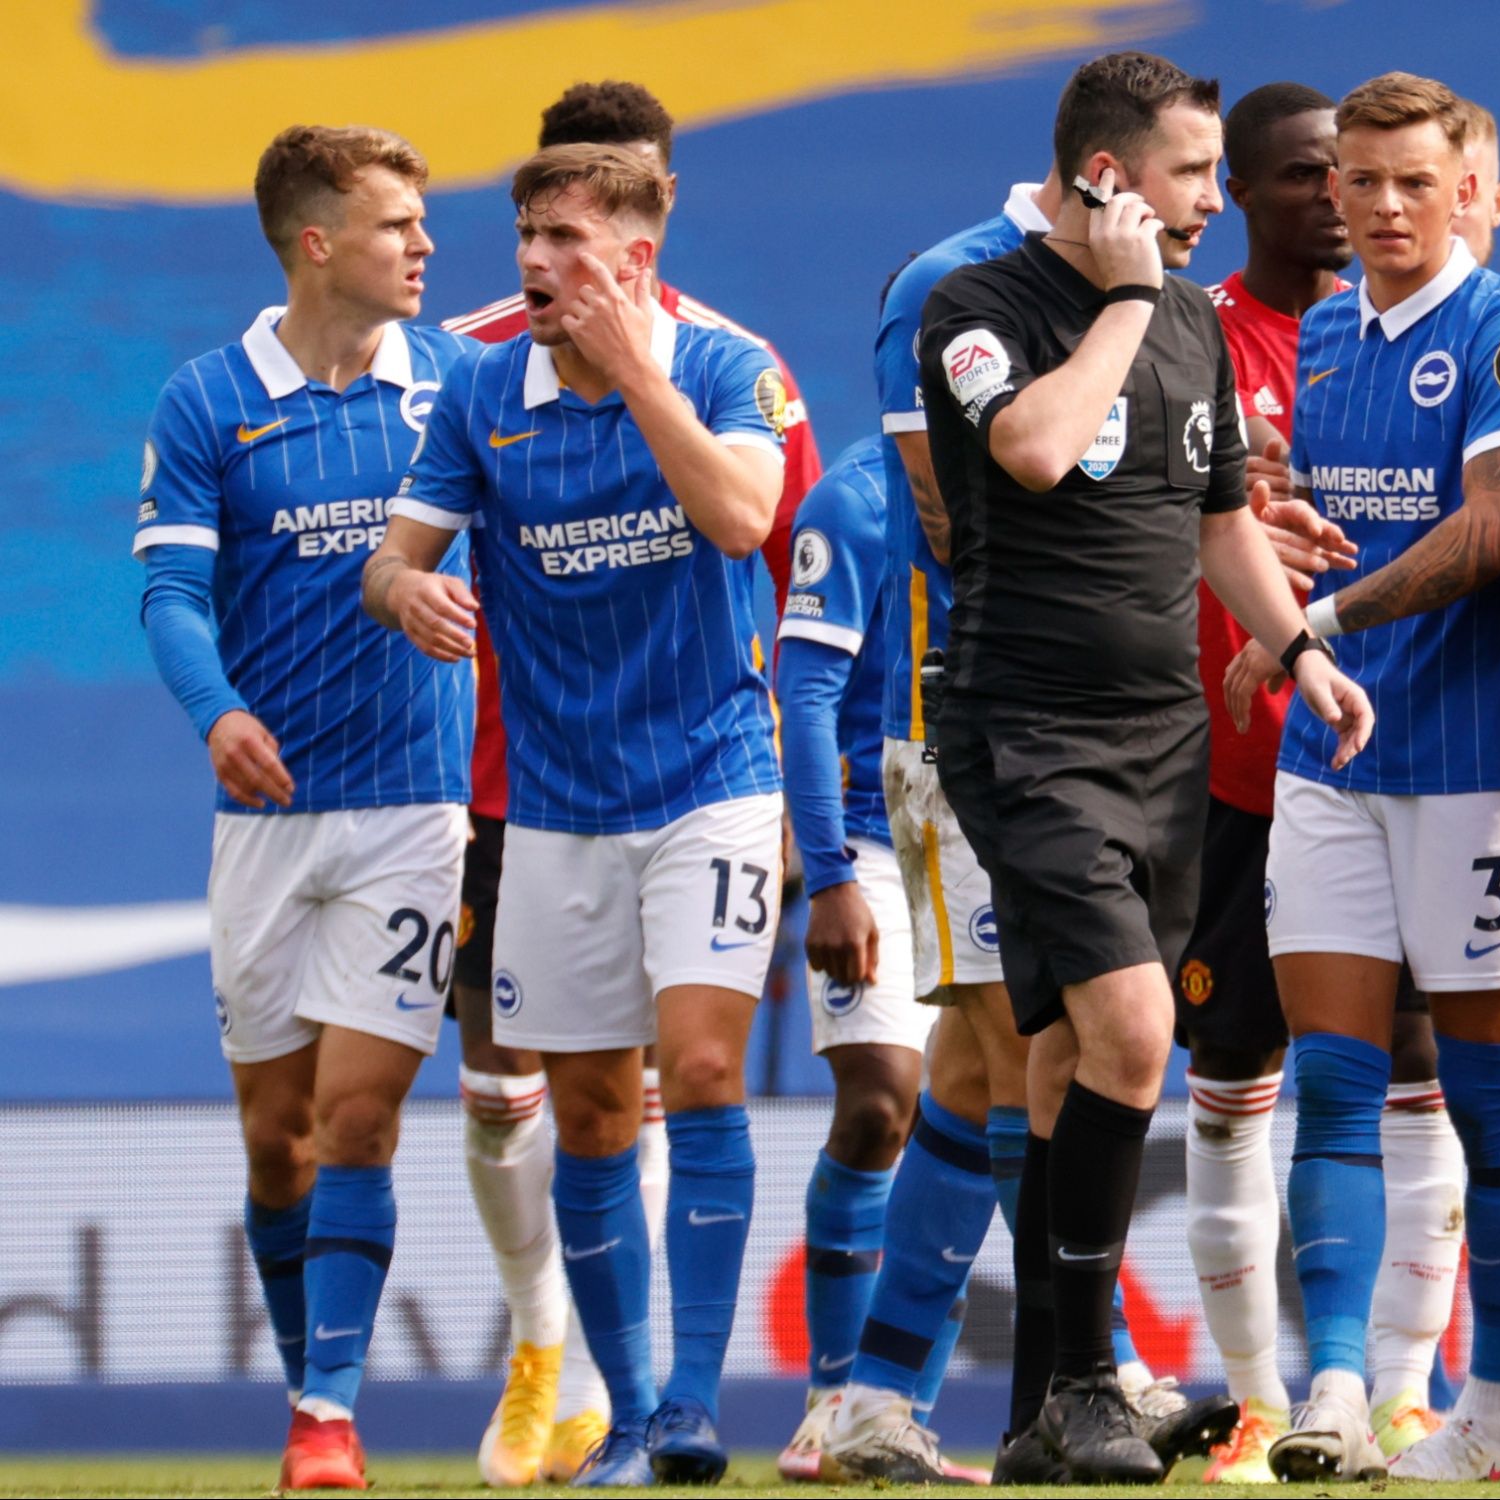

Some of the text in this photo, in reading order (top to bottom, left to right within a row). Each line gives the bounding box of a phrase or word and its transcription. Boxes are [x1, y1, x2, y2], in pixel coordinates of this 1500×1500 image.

[950, 344, 994, 379] EA
[1094, 435, 1121, 446] EREE
[1087, 461, 1109, 473] 2020
[1311, 465, 1435, 493] AMERICAN
[1323, 494, 1441, 521] EXPRESS
[298, 526, 388, 557] EXPR
[520, 505, 686, 549] AMERICAN
[540, 531, 694, 575] EXPRESS
[709, 857, 769, 935] 13
[376, 907, 454, 996] 20
